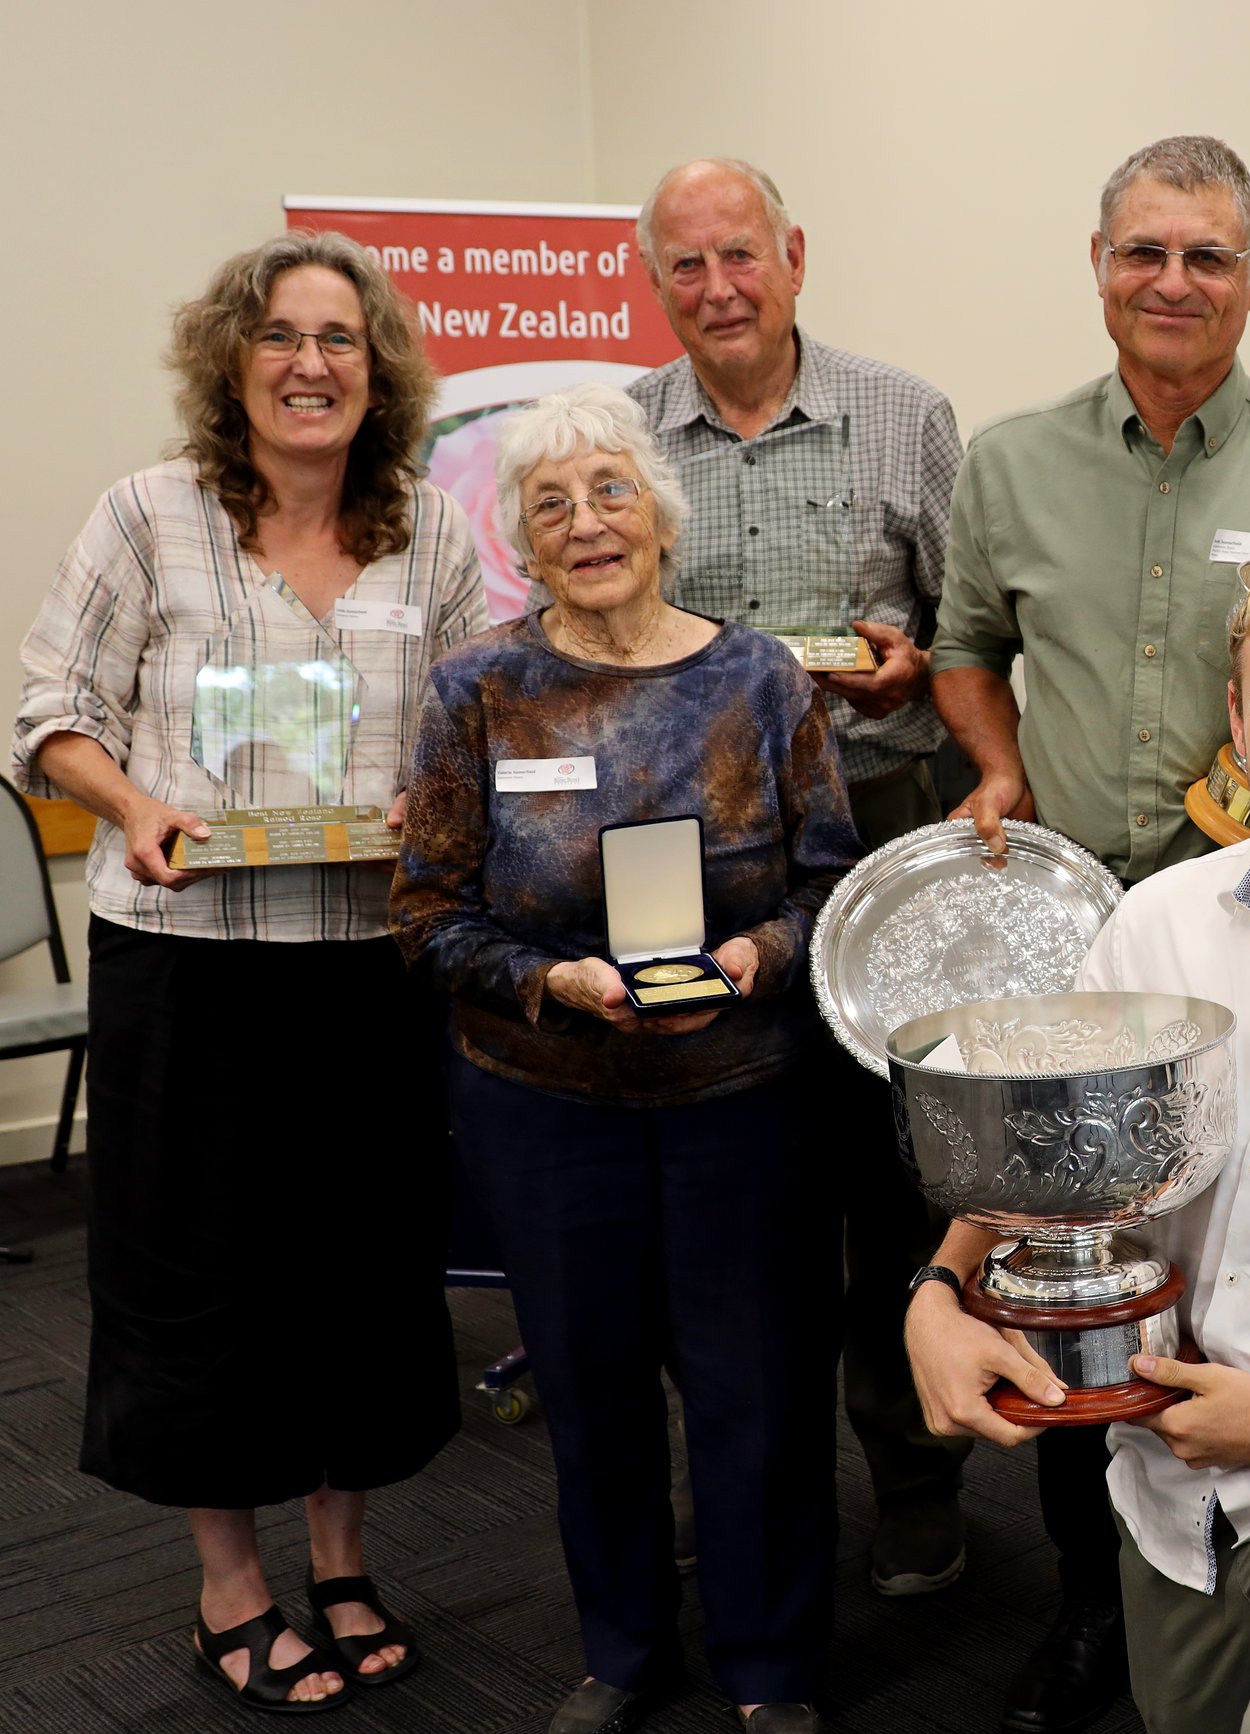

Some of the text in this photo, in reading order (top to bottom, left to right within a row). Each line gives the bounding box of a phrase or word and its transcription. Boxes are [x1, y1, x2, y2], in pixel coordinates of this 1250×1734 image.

[365, 241, 629, 277] ome a member of
[418, 301, 630, 340] New Zealand
[263, 814, 322, 823] Raised Rose
